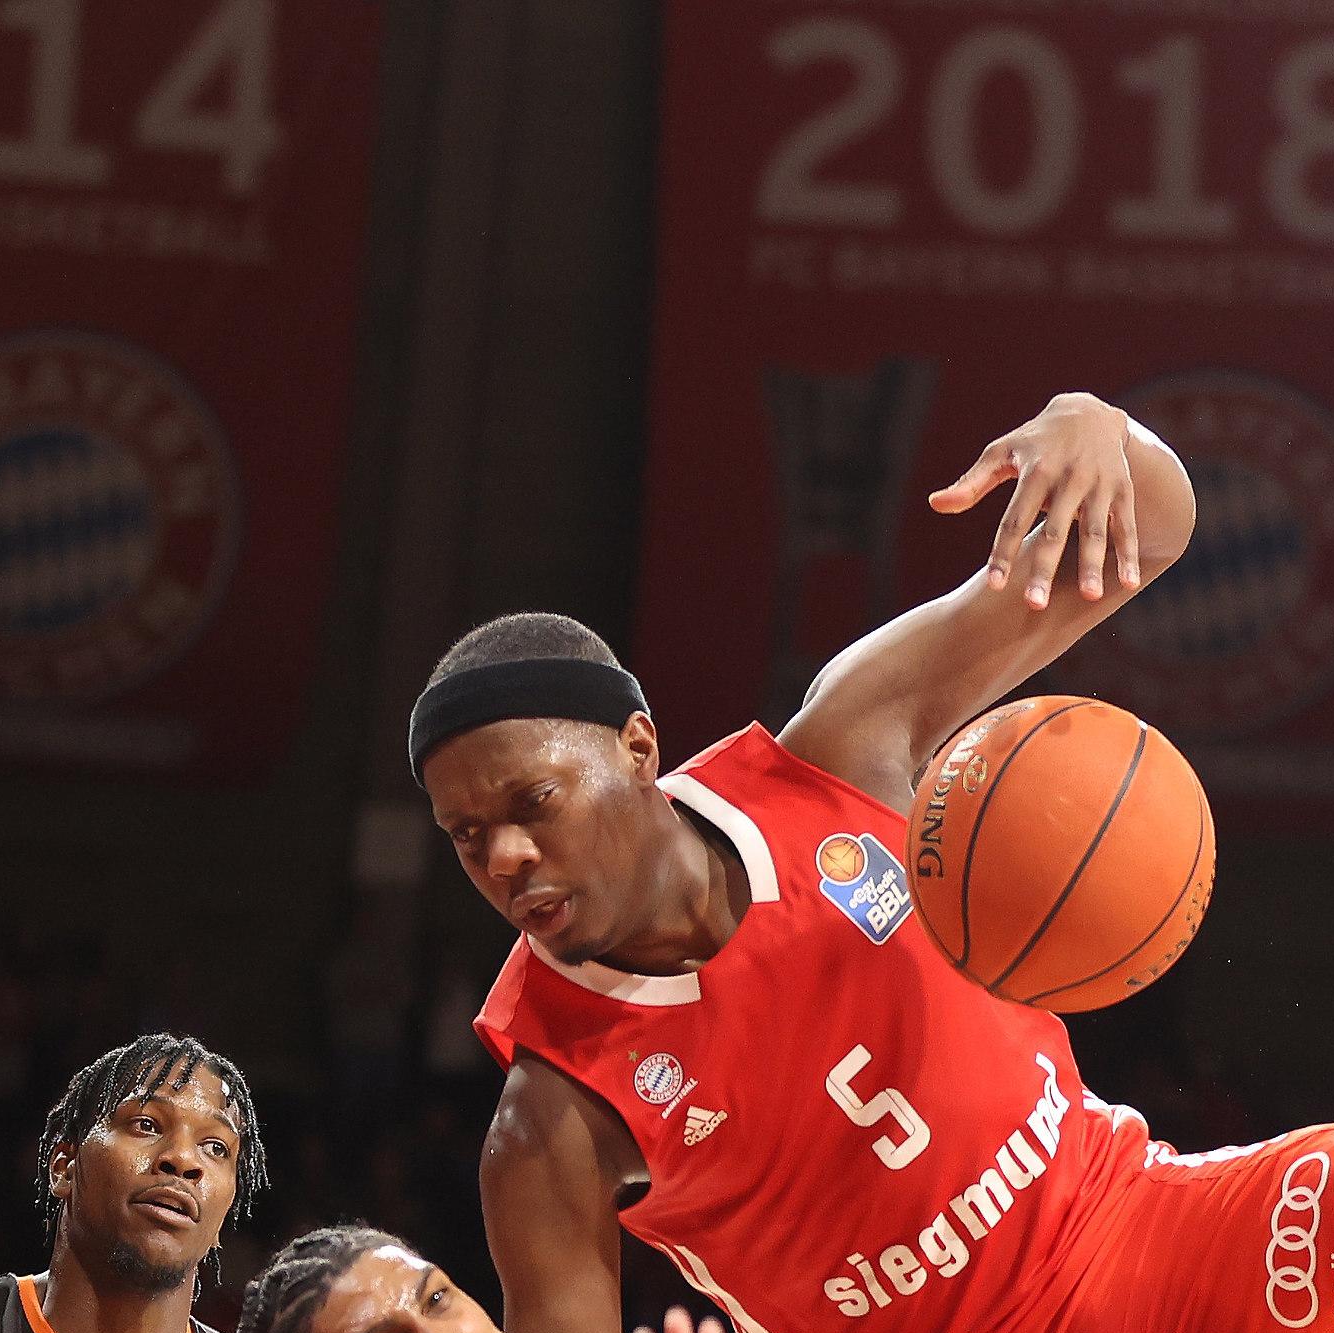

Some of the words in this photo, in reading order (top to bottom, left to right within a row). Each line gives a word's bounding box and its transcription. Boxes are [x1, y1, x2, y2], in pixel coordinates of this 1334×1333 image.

[865, 881, 910, 935] BBL
[825, 1043, 932, 1171] 5
[823, 1051, 1071, 1318] siegmund
